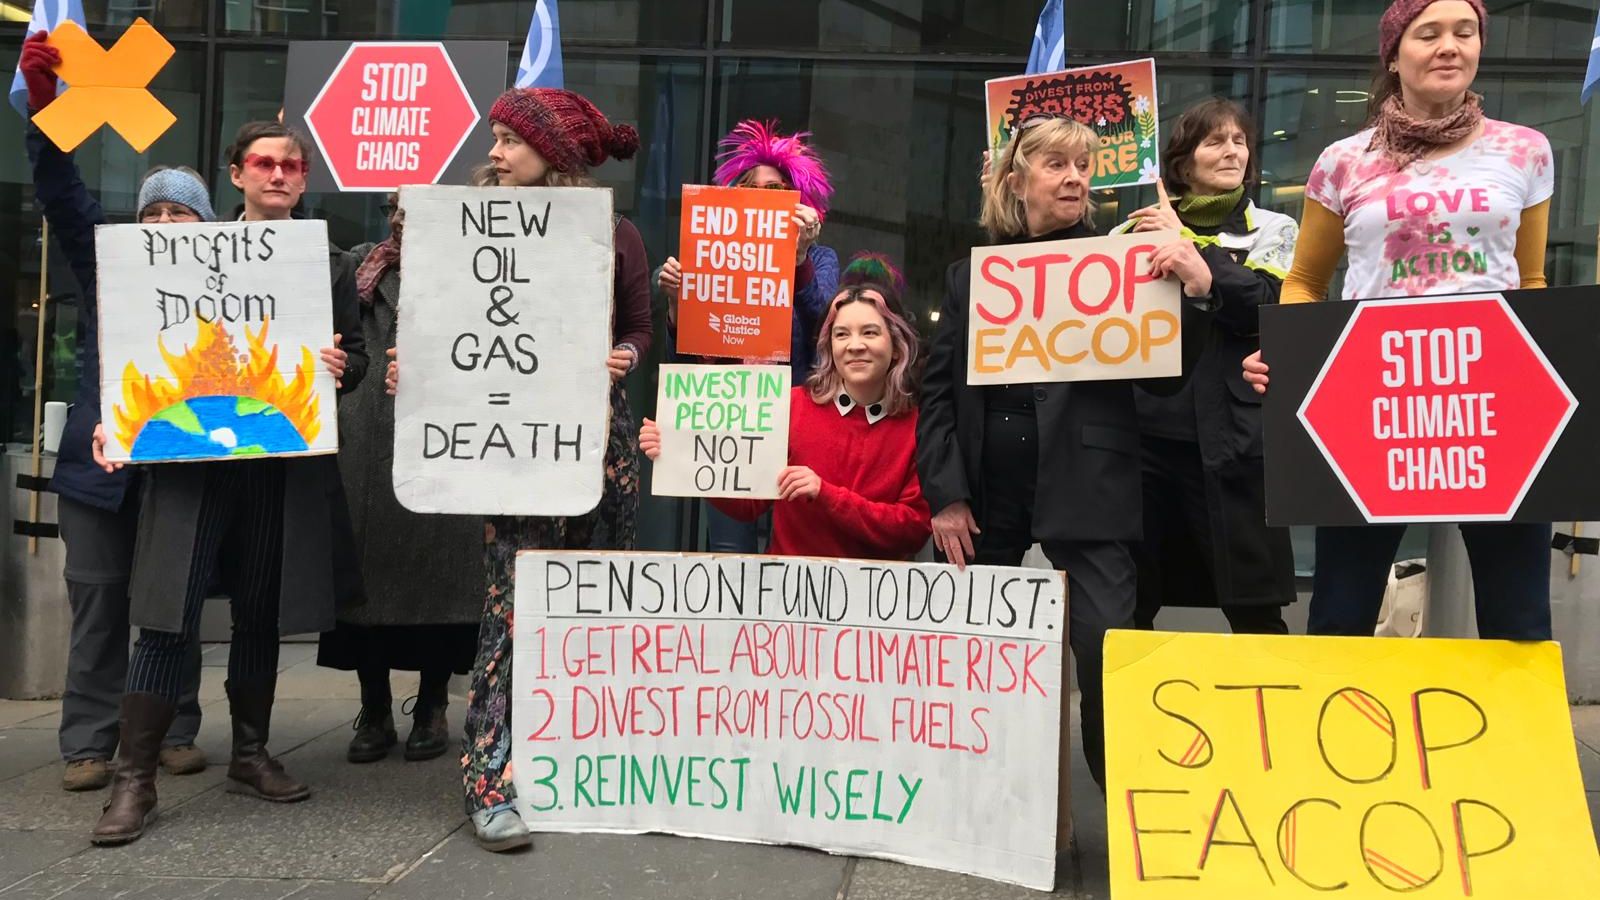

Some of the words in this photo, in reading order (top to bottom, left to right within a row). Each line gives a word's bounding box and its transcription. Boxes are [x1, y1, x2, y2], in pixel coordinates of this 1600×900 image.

[361, 63, 427, 101] STOP
[1025, 84, 1073, 102] DIVEST
[1076, 81, 1114, 94] FROM
[351, 107, 431, 136] CLIMATE
[356, 141, 420, 171] CHAOS
[462, 200, 551, 237] NEW
[690, 205, 738, 235] END
[744, 208, 790, 239] THE
[1386, 188, 1490, 221] LOVE
[1426, 222, 1452, 243] IS
[472, 245, 530, 283] OIL
[696, 239, 780, 273] FOSSIL
[1391, 250, 1488, 282] ACTION
[205, 273, 228, 294] of
[682, 272, 740, 305] FUEL
[746, 277, 790, 308] ERA
[976, 244, 1162, 325] STOP
[155, 287, 276, 331] Doom
[486, 285, 520, 326] &
[723, 314, 760, 326] Global
[722, 325, 760, 336] Justice
[723, 336, 744, 345] Now
[974, 309, 1180, 373] EACOP
[451, 332, 538, 375] GAS
[1381, 326, 1482, 388] STOP
[665, 370, 752, 400] INVEST
[757, 372, 782, 399] IN
[675, 401, 774, 432] PEOPLE
[1372, 392, 1497, 440] CLIMATE
[423, 422, 582, 461] DEATH
[694, 435, 764, 464] NOT
[695, 465, 751, 491] OIL
[1387, 445, 1486, 491] CHAOS
[546, 560, 745, 616] PENSION
[757, 562, 848, 622] FUND
[859, 567, 898, 620] TO
[906, 568, 956, 623] DO
[965, 571, 1057, 630] LIST:
[631, 623, 720, 674] REAL
[729, 623, 828, 681] ABOUT
[834, 629, 958, 687] CLIMATE
[966, 637, 1047, 697] RISK
[527, 688, 561, 741] 2.
[571, 685, 684, 740] DIVEST
[696, 685, 769, 739] FROM
[779, 689, 879, 742] FOSSIL
[892, 697, 990, 754] FUELS
[1152, 678, 1488, 790] STOP
[530, 755, 564, 811] 3.
[574, 754, 750, 812] REINVEST
[772, 765, 923, 824] WISELY
[1126, 788, 1516, 896] EACOP
